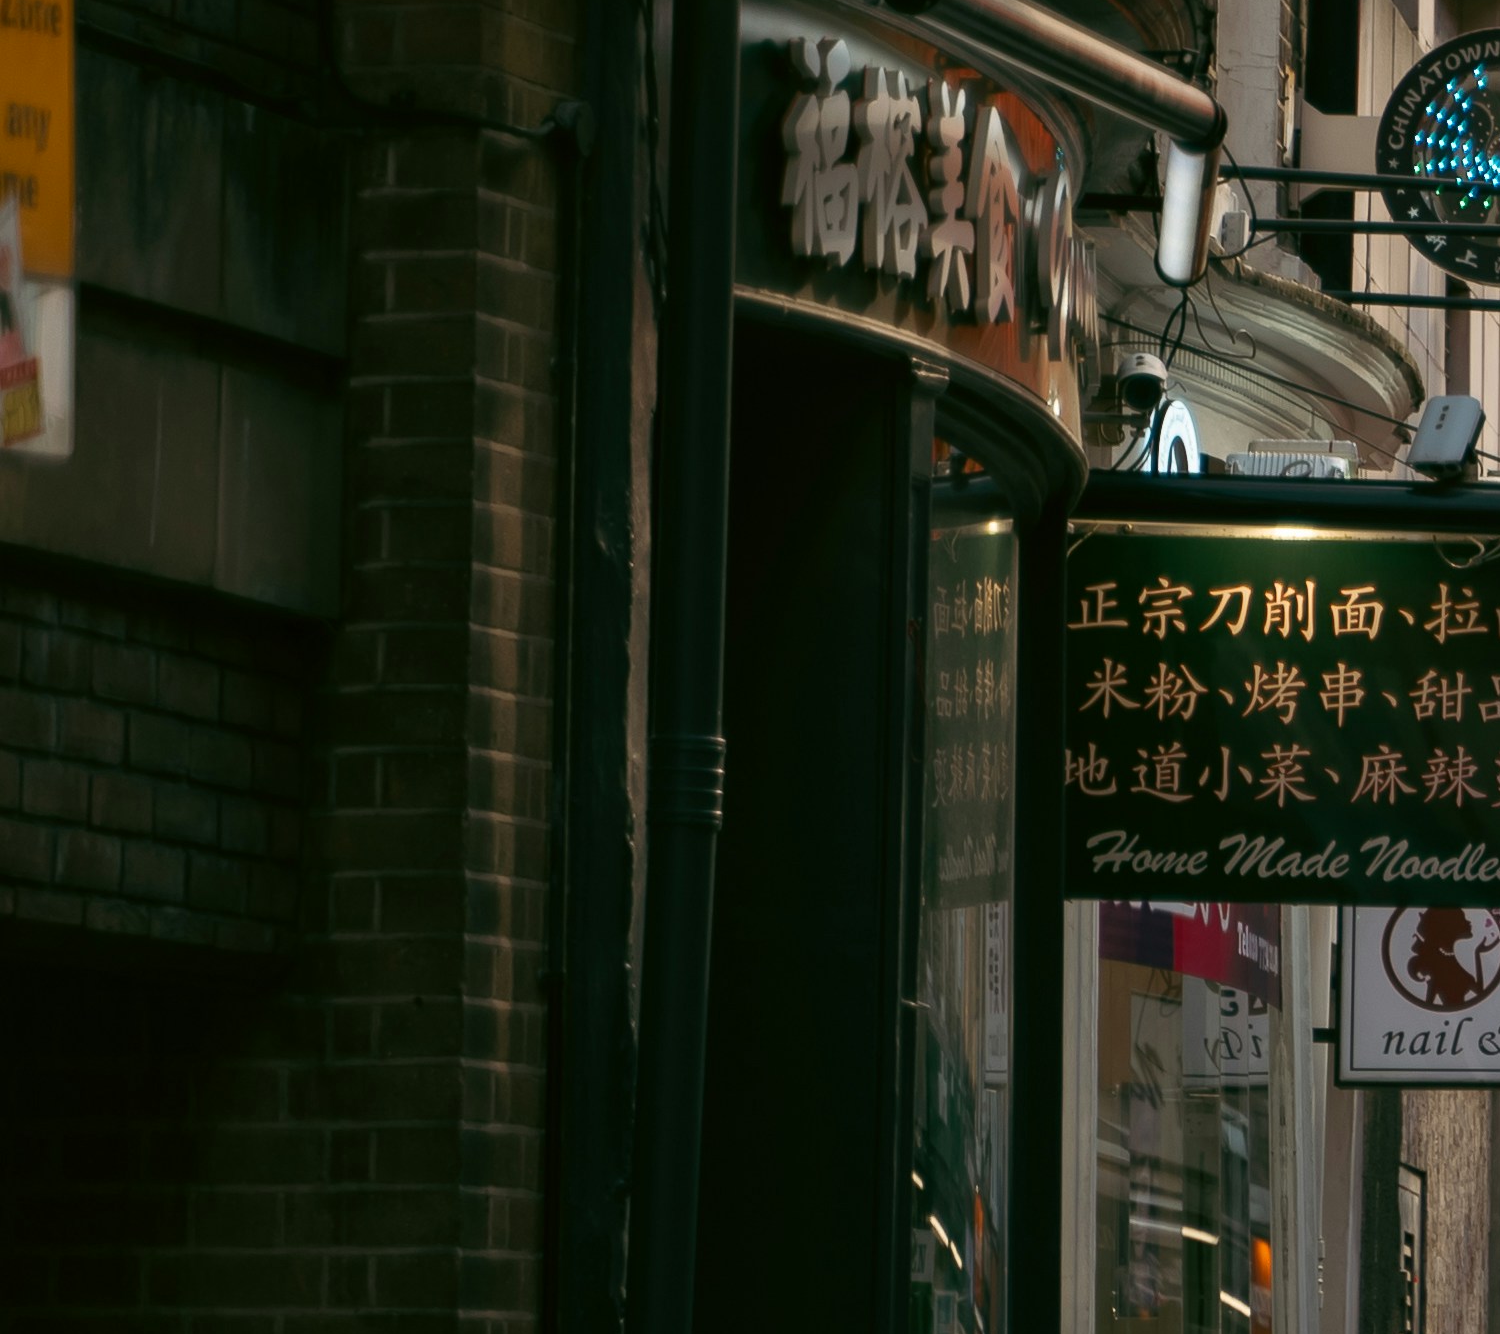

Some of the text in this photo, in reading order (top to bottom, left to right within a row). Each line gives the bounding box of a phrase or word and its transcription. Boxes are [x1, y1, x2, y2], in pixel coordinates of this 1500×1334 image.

[1387, 39, 1500, 152] CHINATOWN
[1085, 828, 1209, 878] Home
[1217, 831, 1351, 880] Made
[1381, 1016, 1474, 1058] nail
